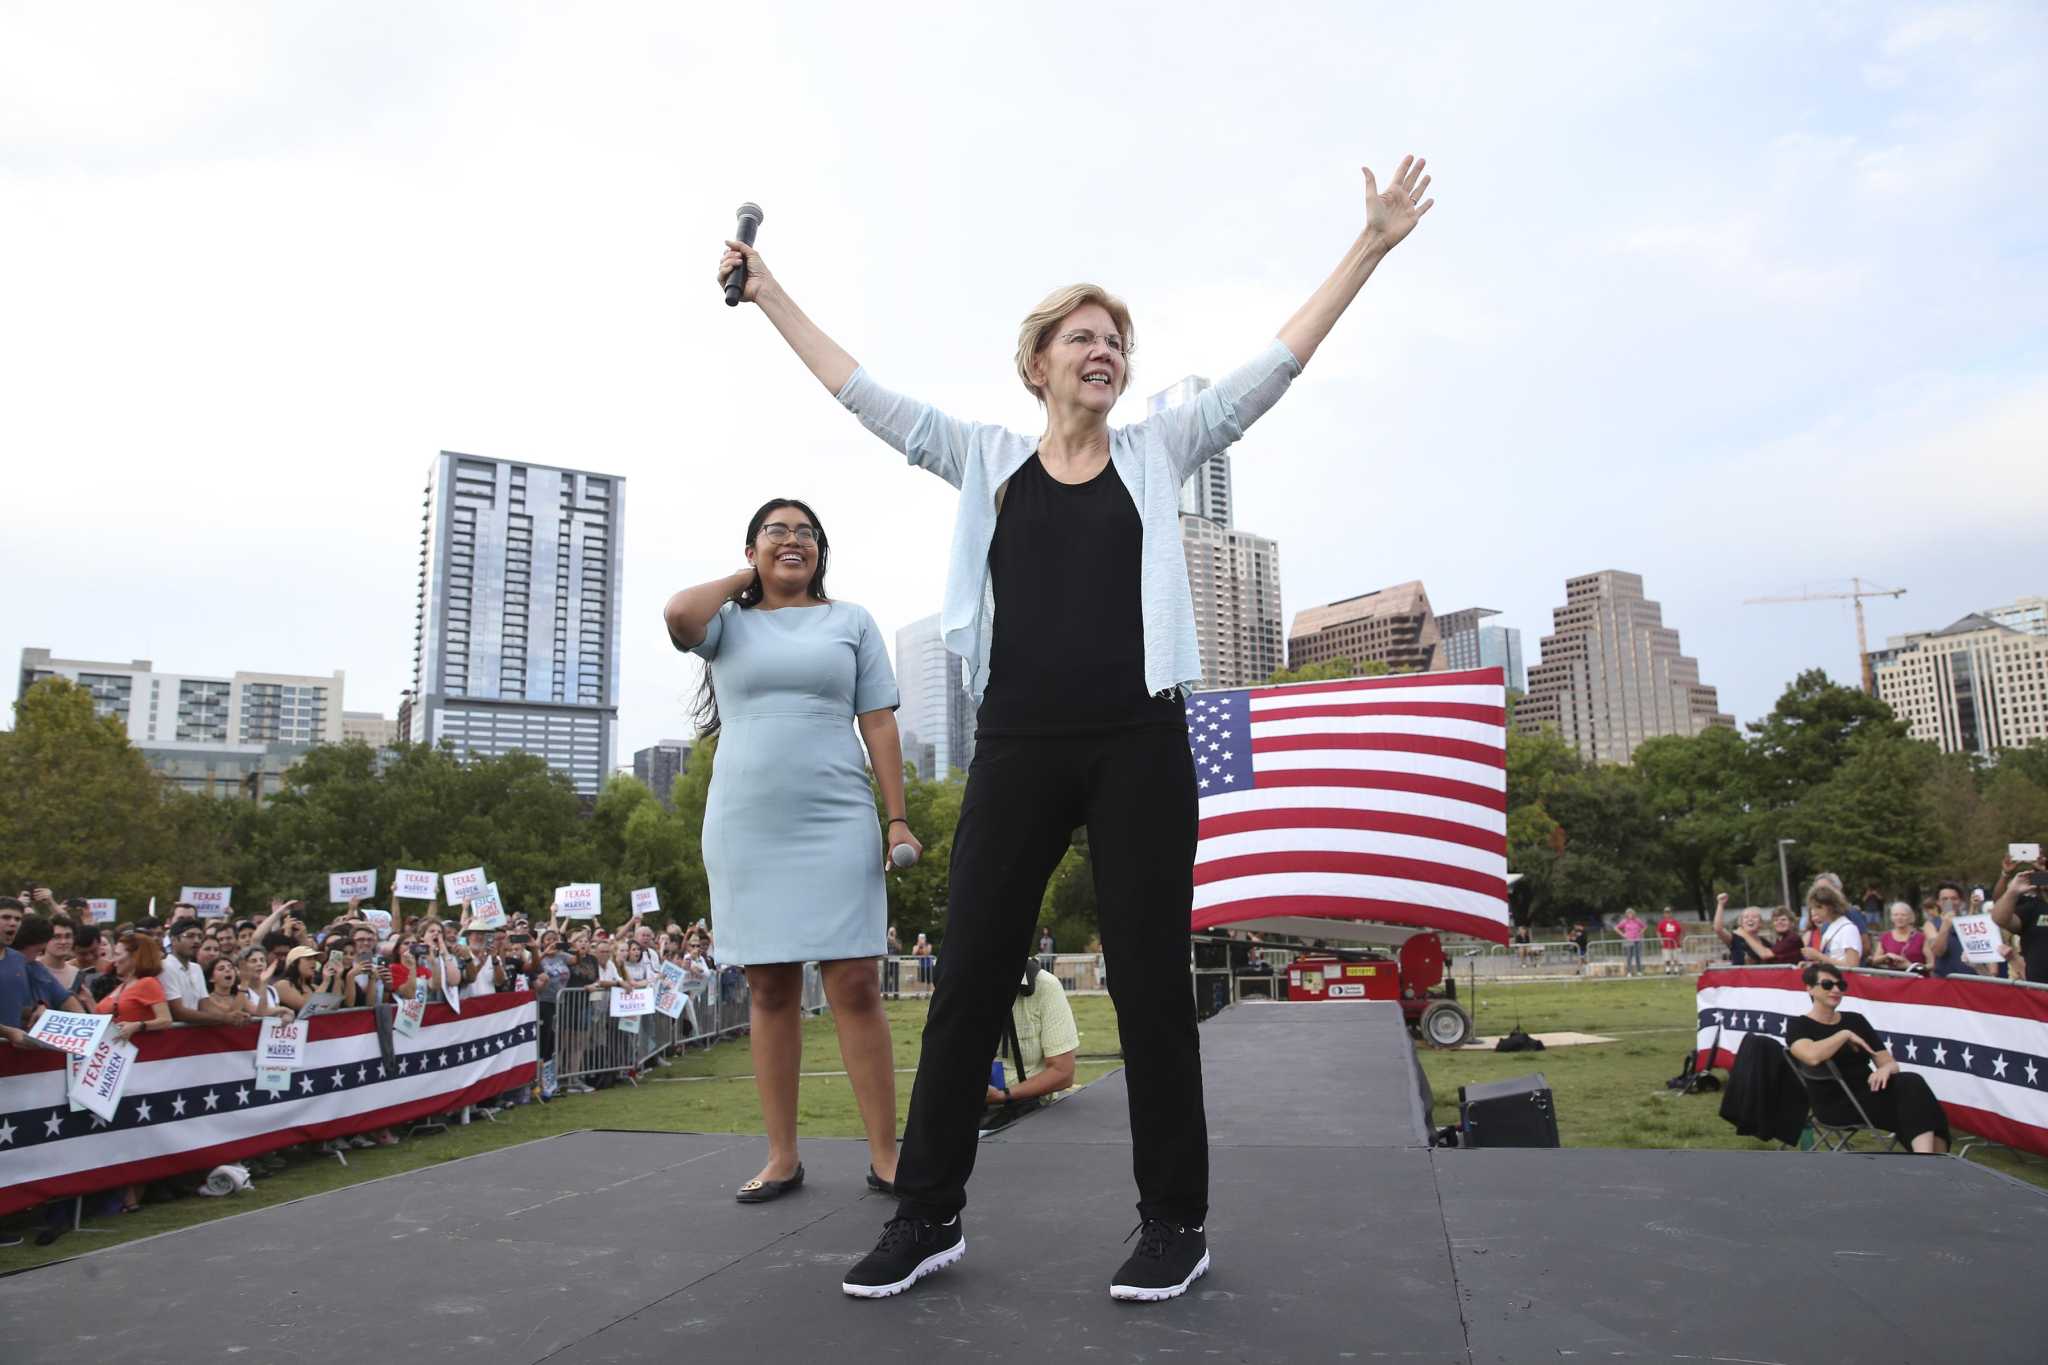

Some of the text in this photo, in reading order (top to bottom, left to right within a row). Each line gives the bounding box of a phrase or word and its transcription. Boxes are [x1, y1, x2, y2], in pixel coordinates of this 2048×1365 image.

[340, 875, 368, 885] TEXAS
[405, 873, 430, 883] TEXAS
[452, 874, 477, 885] TEXAS
[193, 891, 222, 900] TEXAS
[564, 889, 591, 898] TEXAS
[1958, 921, 1988, 936] TEXAS
[48, 1014, 100, 1026] DREAM
[42, 1022, 95, 1038] BIG
[271, 1025, 298, 1040] TEXAS
[36, 1031, 90, 1047] FIGHT
[82, 1040, 111, 1088] TEXAS
[97, 1051, 122, 1098] WARREN
